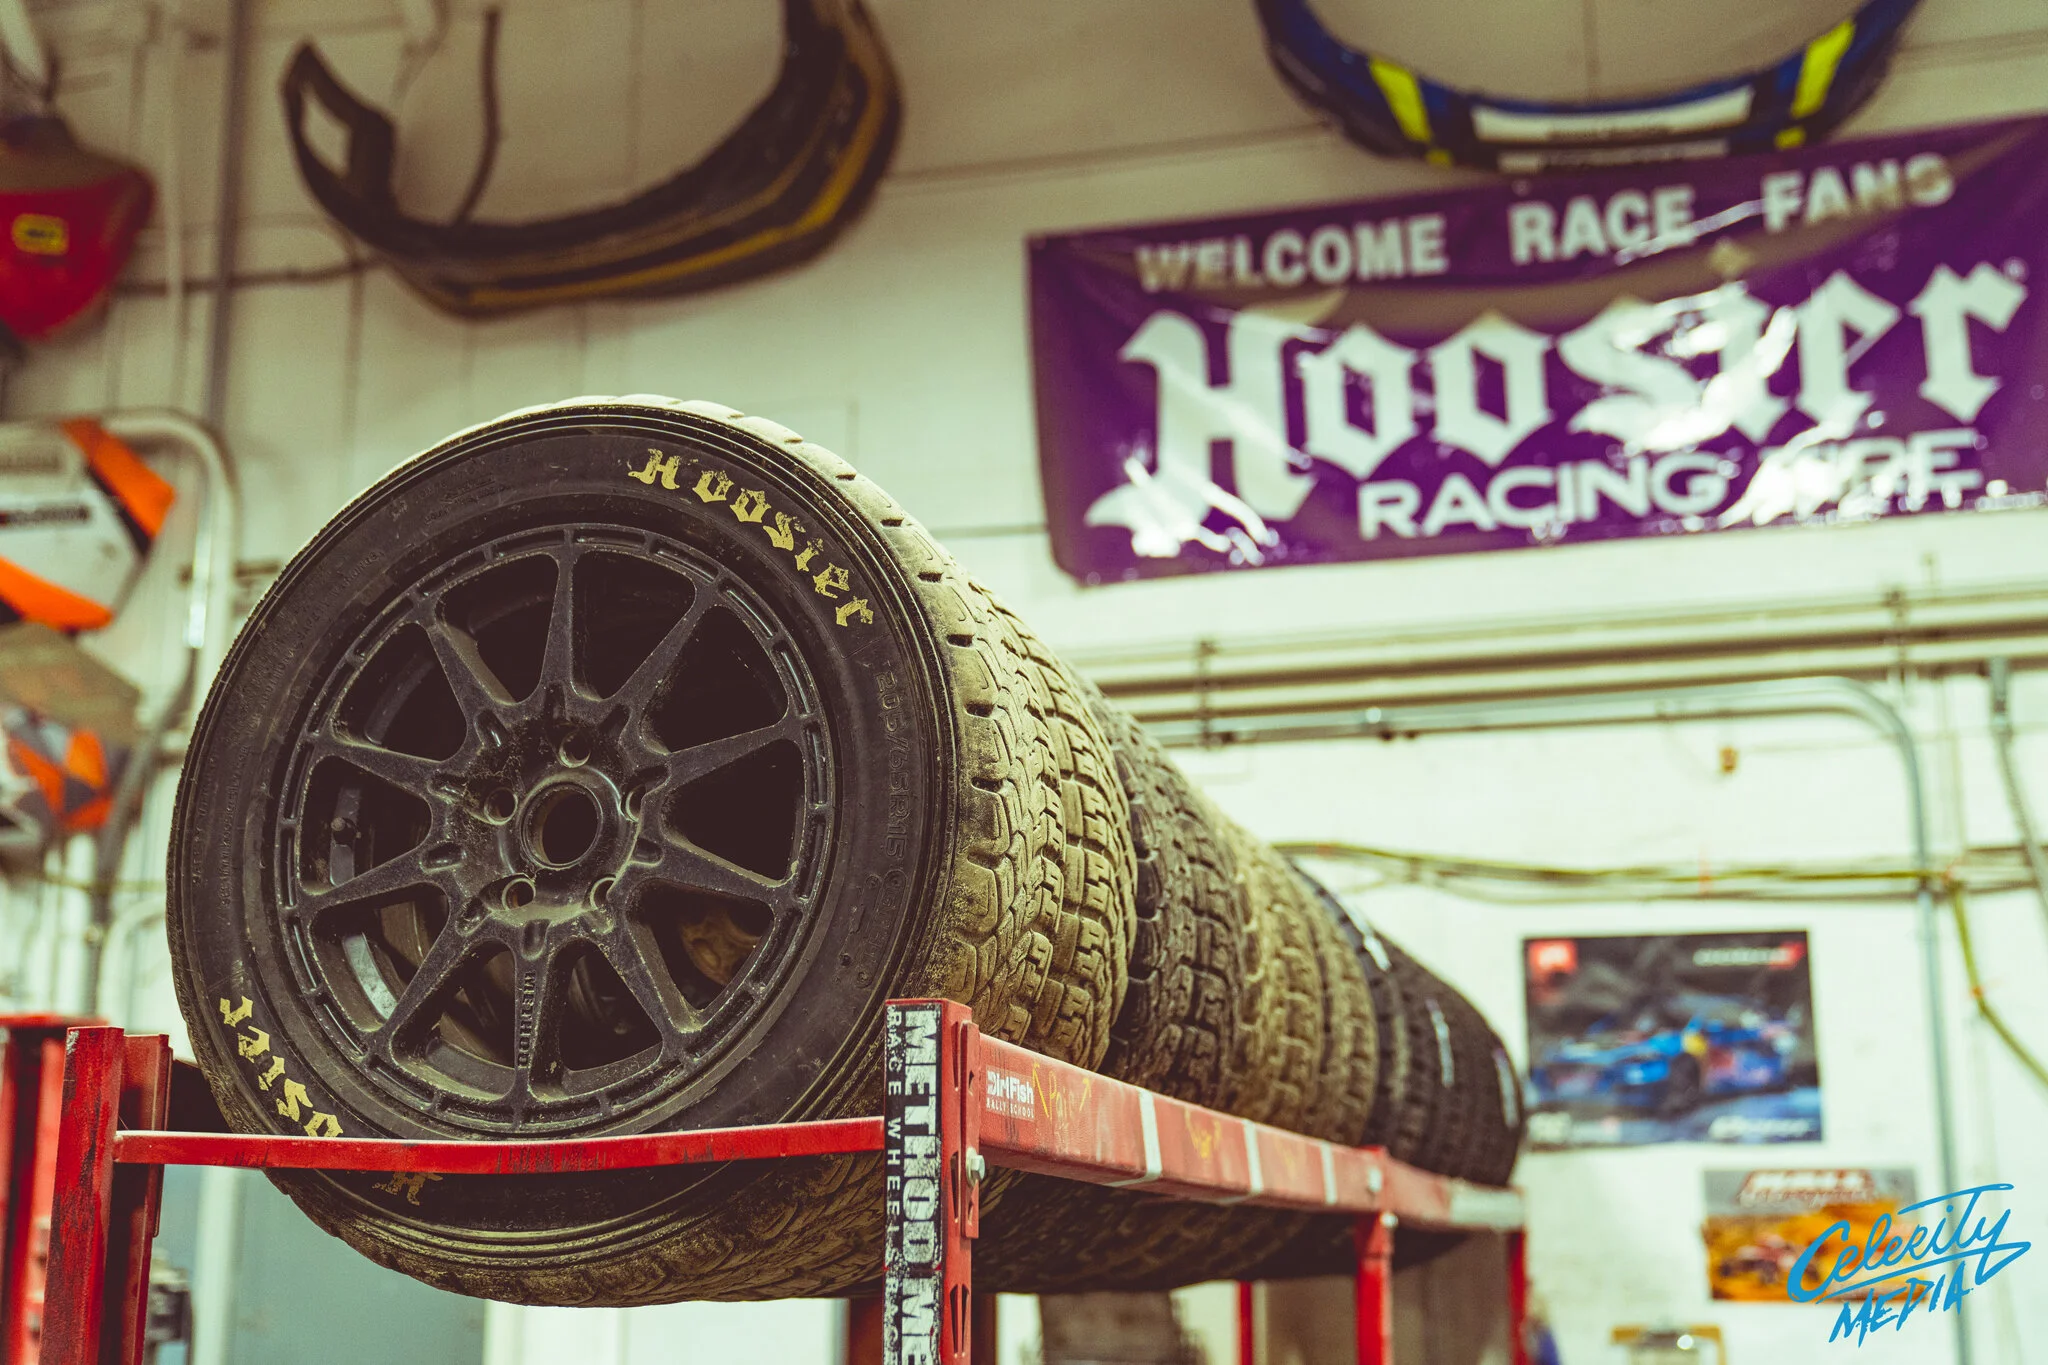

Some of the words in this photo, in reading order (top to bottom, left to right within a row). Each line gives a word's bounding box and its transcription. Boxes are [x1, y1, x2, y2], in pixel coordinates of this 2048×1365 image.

[1135, 214, 1449, 293] WELCOME
[1508, 185, 1697, 264] RACE
[1761, 151, 1957, 233] FANS
[1084, 260, 2028, 558] Hoosier
[628, 448, 874, 627] Hoosier
[1357, 450, 1729, 540] RACING
[1761, 427, 1983, 508] RE
[517, 971, 536, 1069] METHOD
[887, 1013, 902, 1096] RACE
[902, 1009, 938, 1265] METHOD
[986, 1097, 1006, 1112] RALLY
[1010, 1103, 1034, 1119] SCHOOL
[987, 1070, 1034, 1105] DirtFish
